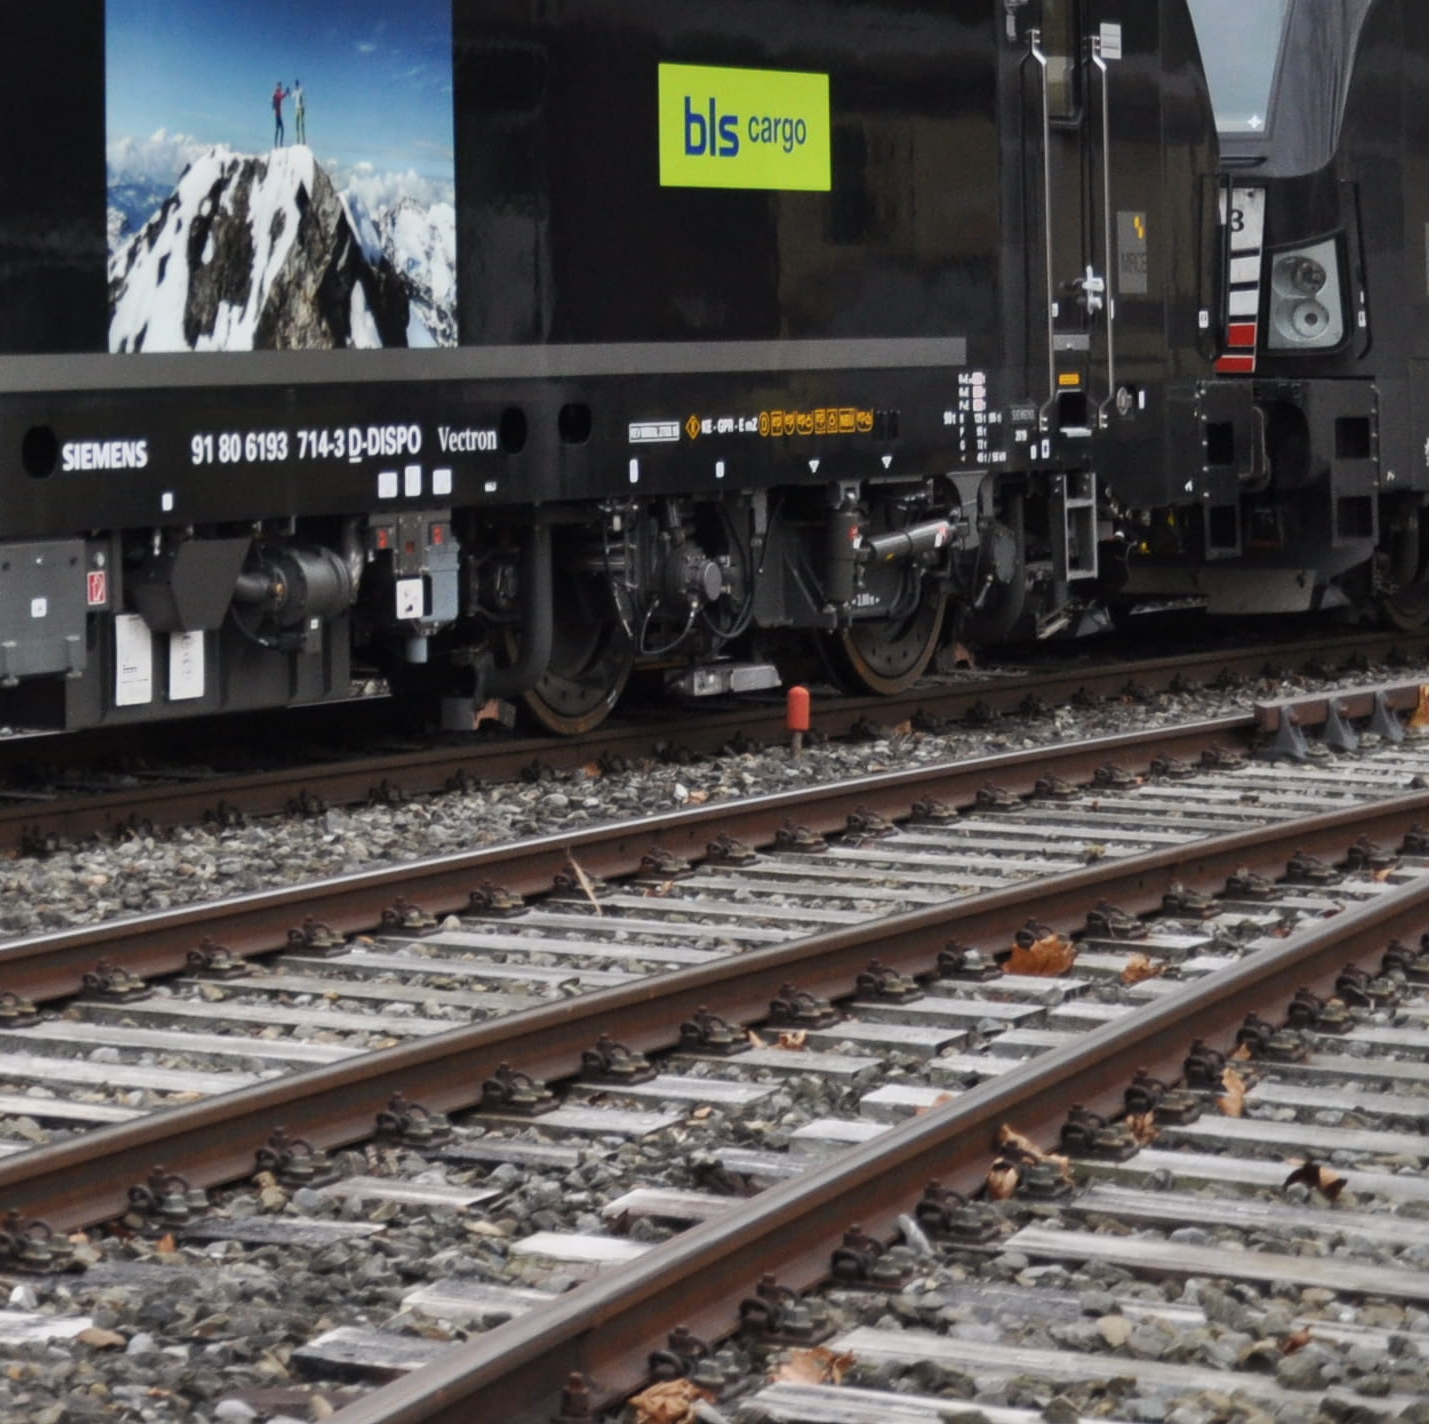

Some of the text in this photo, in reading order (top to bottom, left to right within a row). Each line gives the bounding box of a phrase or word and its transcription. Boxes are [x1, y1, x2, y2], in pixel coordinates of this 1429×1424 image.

[684, 96, 807, 157] bls cargo
[62, 440, 149, 471] SIEMENS
[192, 434, 213, 465] 91
[218, 432, 241, 464] 80
[245, 431, 288, 462] 6193
[297, 429, 345, 459] 714-3
[438, 426, 498, 452] Vectron
